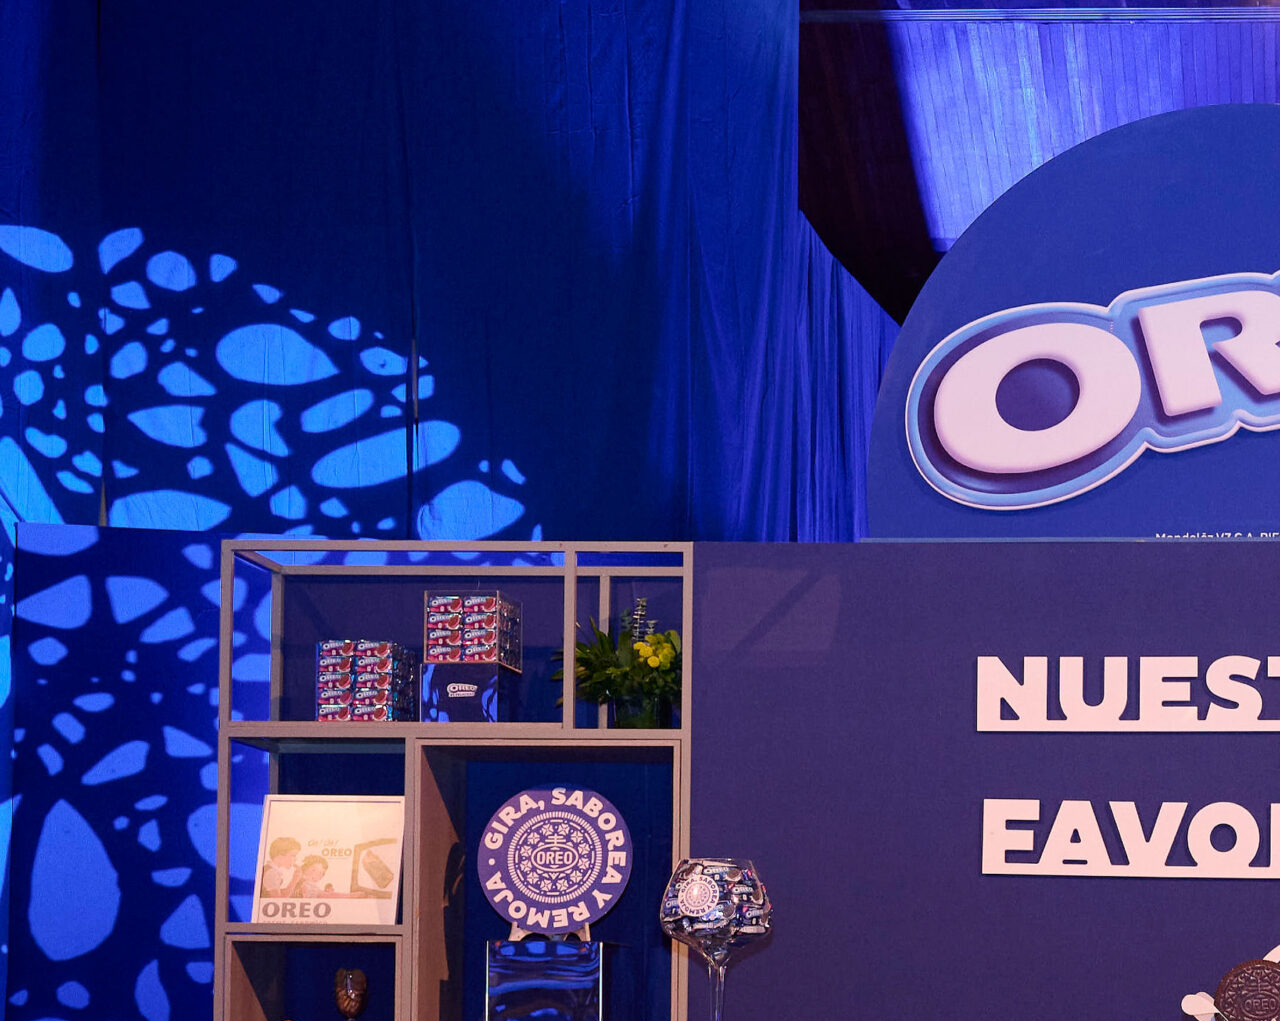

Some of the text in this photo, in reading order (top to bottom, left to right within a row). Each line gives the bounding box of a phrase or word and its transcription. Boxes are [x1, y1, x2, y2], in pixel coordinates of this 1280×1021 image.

[321, 848, 352, 857] OREO
[484, 787, 627, 929] GIRA, SABOREA Y REMOJA
[536, 851, 573, 865] OREO
[262, 902, 332, 918] OREO
[1245, 999, 1275, 1010] OREO
